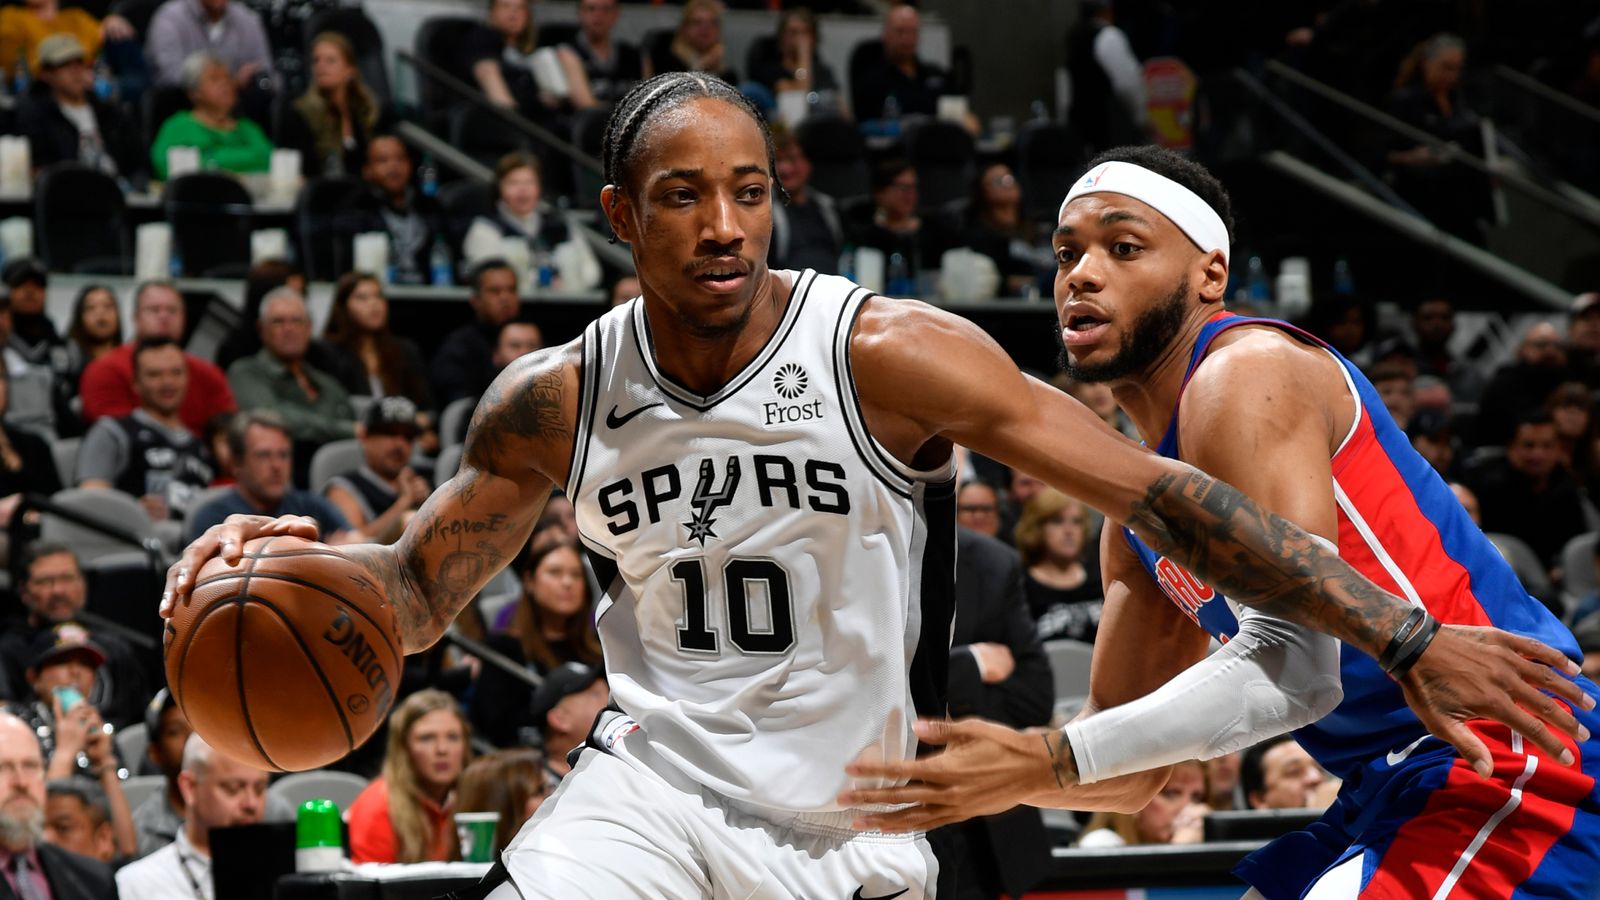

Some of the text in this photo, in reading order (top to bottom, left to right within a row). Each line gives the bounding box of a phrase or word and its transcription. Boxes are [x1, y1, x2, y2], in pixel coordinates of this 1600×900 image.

[762, 399, 823, 425] Frost
[598, 454, 851, 548] SPURS
[667, 554, 798, 657] 10
